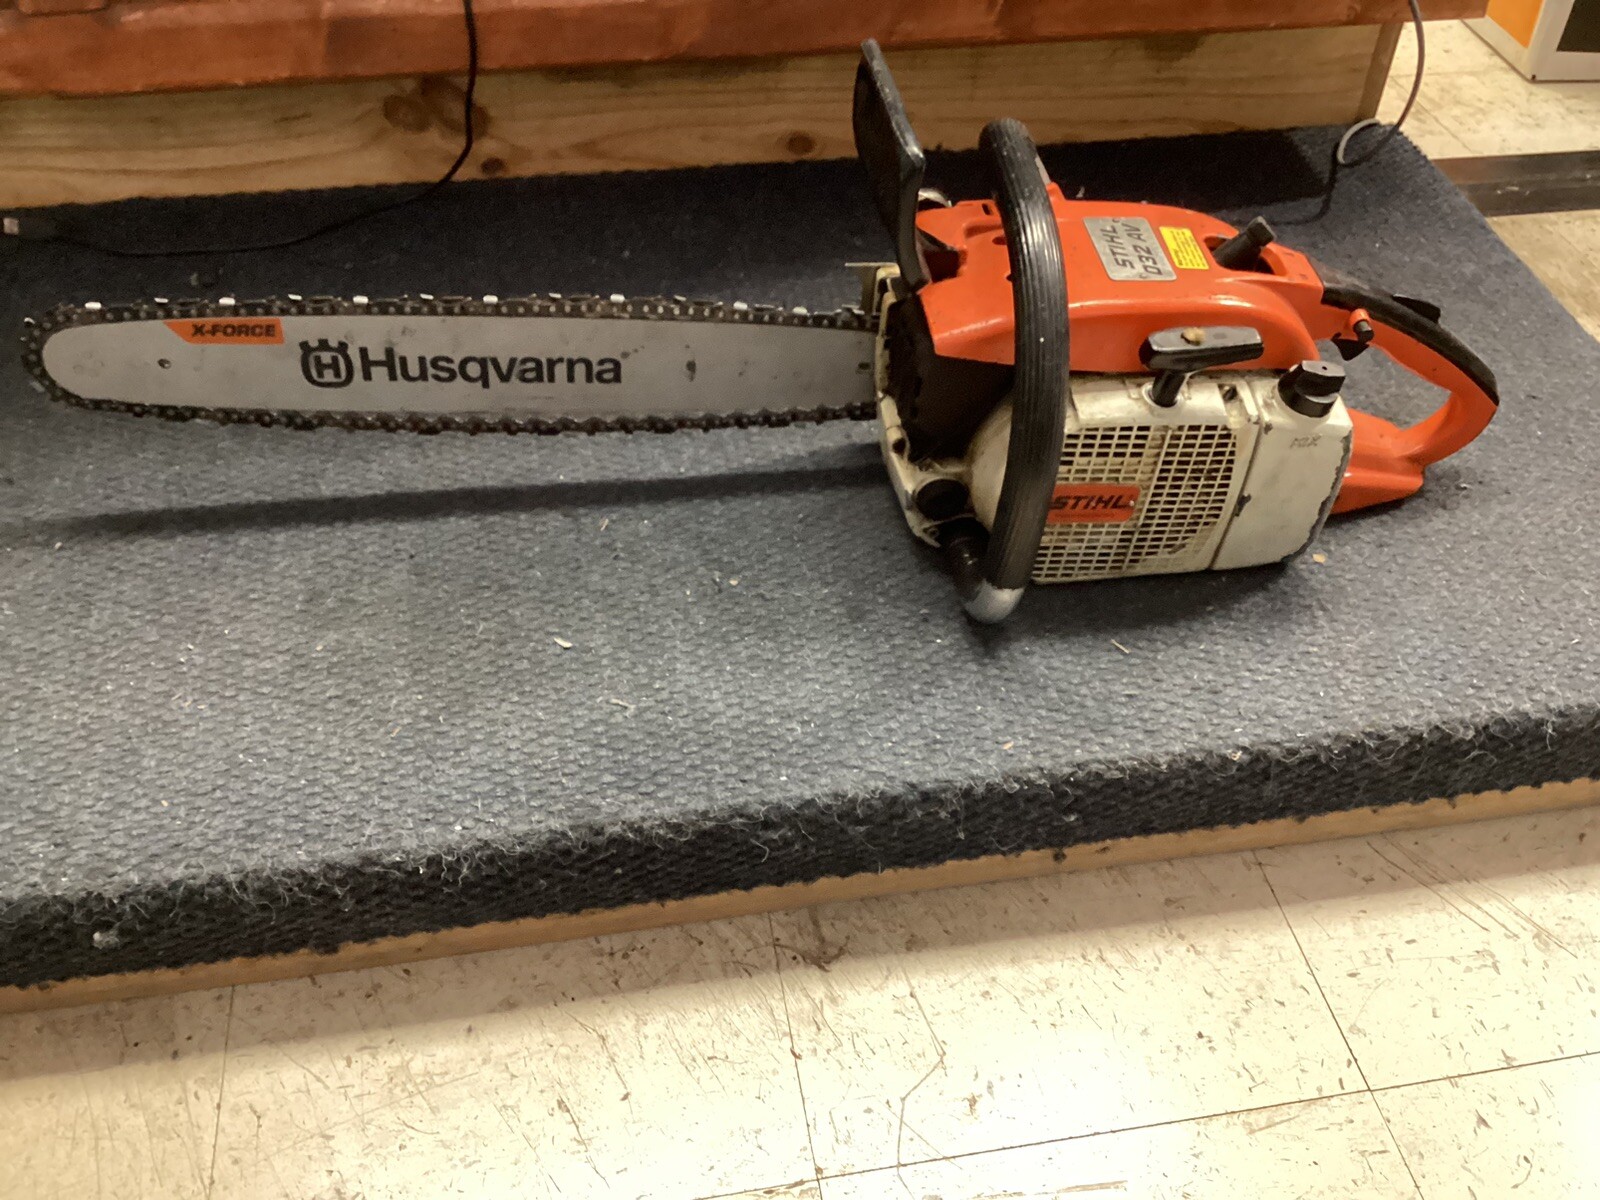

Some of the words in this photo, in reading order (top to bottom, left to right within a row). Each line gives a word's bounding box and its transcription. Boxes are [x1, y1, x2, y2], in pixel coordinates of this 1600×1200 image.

[1121, 222, 1147, 242] AV
[1100, 224, 1136, 270] STIHL
[1132, 244, 1163, 276] 032
[192, 323, 276, 338] X-FORCE
[358, 346, 623, 389] Husqvarna
[1048, 494, 1134, 511] STIHL
